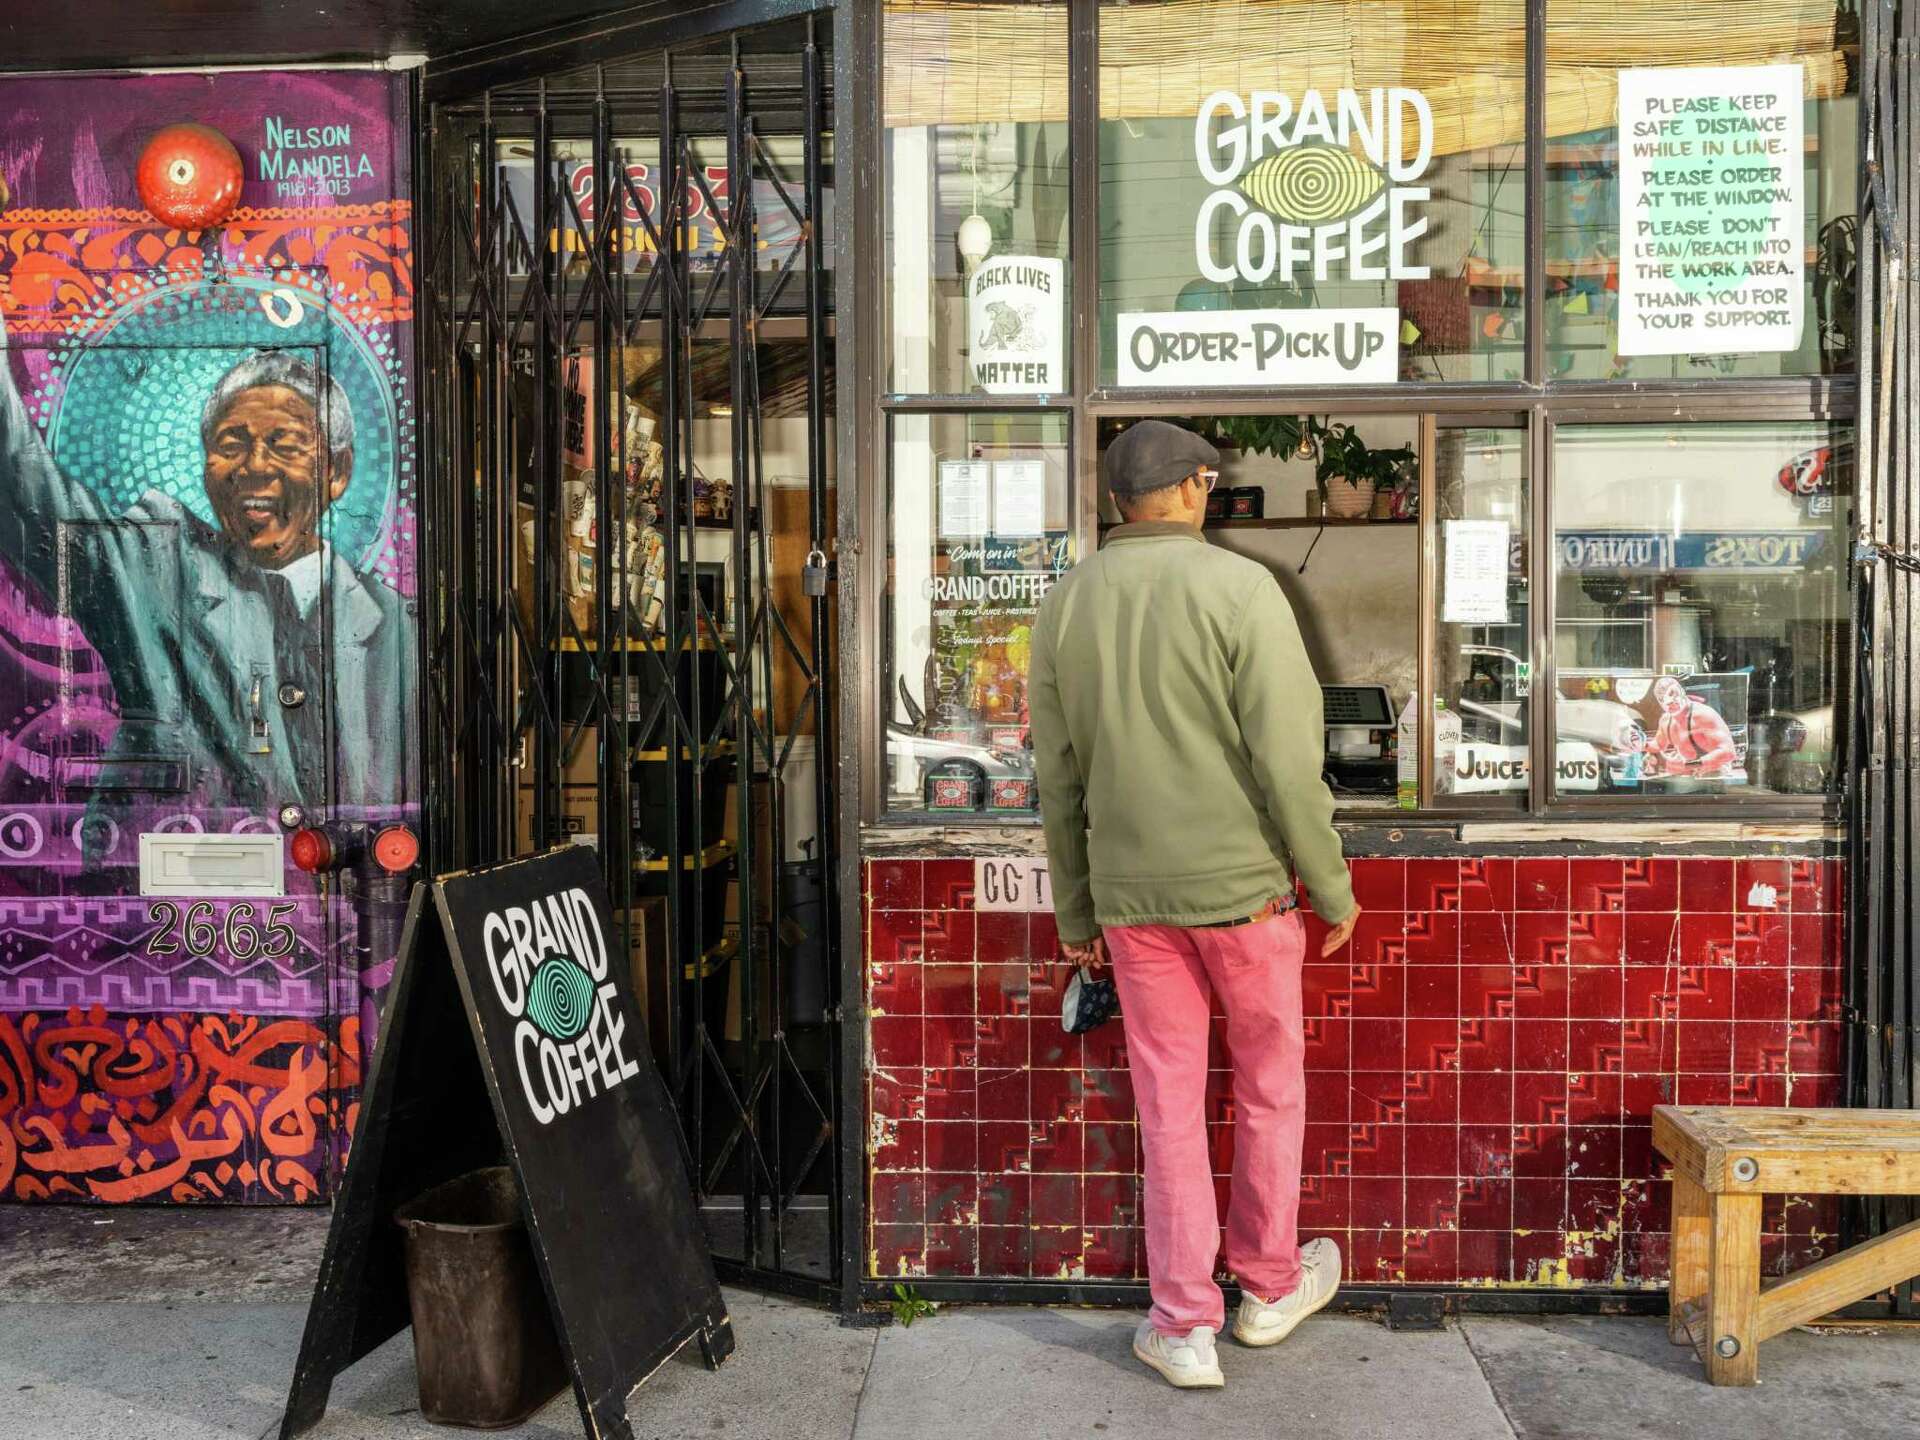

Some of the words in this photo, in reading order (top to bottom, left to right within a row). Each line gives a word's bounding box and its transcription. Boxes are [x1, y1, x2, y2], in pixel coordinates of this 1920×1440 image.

[1646, 96, 1720, 114] PLEASE
[1729, 94, 1777, 111] KEEP
[266, 116, 351, 149] NELSON
[1195, 88, 1433, 185] GRAND
[1633, 120, 1684, 137] SAFE
[1696, 116, 1786, 135] DISTANCE
[1633, 141, 1692, 158] WHILE
[1702, 141, 1724, 156] IN
[1733, 138, 1787, 156] LINE.
[260, 149, 375, 180] MANDELA
[1642, 169, 1713, 186] PLEASE
[1720, 167, 1782, 184] ORDER
[1637, 192, 1664, 207] AT
[1671, 191, 1708, 207] THE
[1715, 188, 1792, 205] WINDOW.
[1196, 187, 1431, 283] COFFEE
[1637, 220, 1710, 236] PLEASE
[1722, 217, 1781, 234] DON'T
[1635, 239, 1748, 259] LEAN/REACH
[1753, 239, 1791, 255] INTO
[1636, 264, 1676, 279] THE
[1682, 261, 1738, 278] WORK
[1742, 260, 1794, 276] AREA.
[976, 265, 1012, 296] BLACK
[1016, 266, 1051, 294] LIVES
[1635, 291, 1702, 308] THANK
[1708, 289, 1748, 306] YOU
[1752, 288, 1788, 304] FOR
[1638, 313, 1694, 329] YOUR
[1704, 310, 1791, 327] SUPPORT.
[976, 362, 1048, 384] MATTER
[922, 576, 984, 600] GRAND
[961, 609, 978, 617] TEAS
[1456, 750, 1524, 780] JUICE
[1555, 760, 1597, 780] HOTS
[147, 901, 297, 959] 2665
[484, 888, 607, 1017] GRAND
[515, 982, 640, 1124] COFFEE
